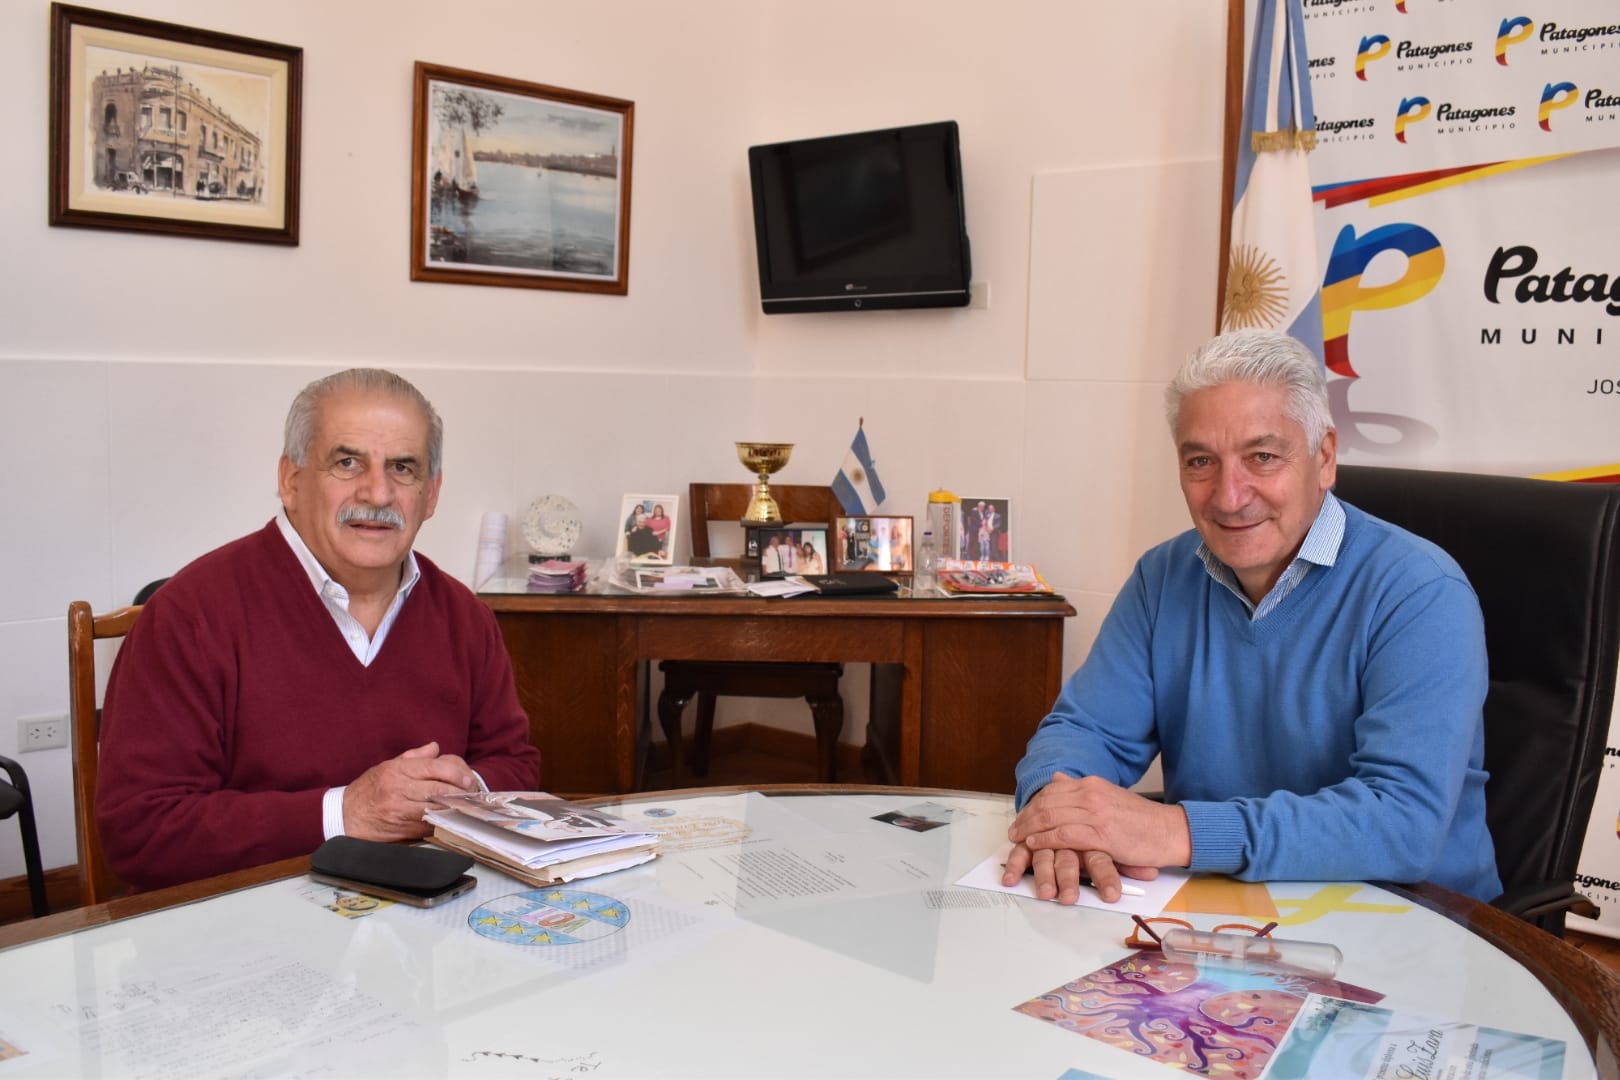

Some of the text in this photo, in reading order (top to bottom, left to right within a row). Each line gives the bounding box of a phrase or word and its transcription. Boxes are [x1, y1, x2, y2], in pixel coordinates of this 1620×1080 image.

[1303, 5, 1375, 19] MUNICIPIO
[1396, 40, 1473, 60] Patagones
[1541, 42, 1620, 55] MUNICIPI
[1397, 57, 1473, 71] MUNICIPIO
[1436, 102, 1516, 123] Patagones
[1585, 114, 1616, 122] MUN
[1314, 115, 1375, 134] atagones
[1437, 123, 1516, 134] MUNICIPIO
[1481, 328, 1602, 345] MUNI
[1406, 1028, 1444, 1060] Zara
